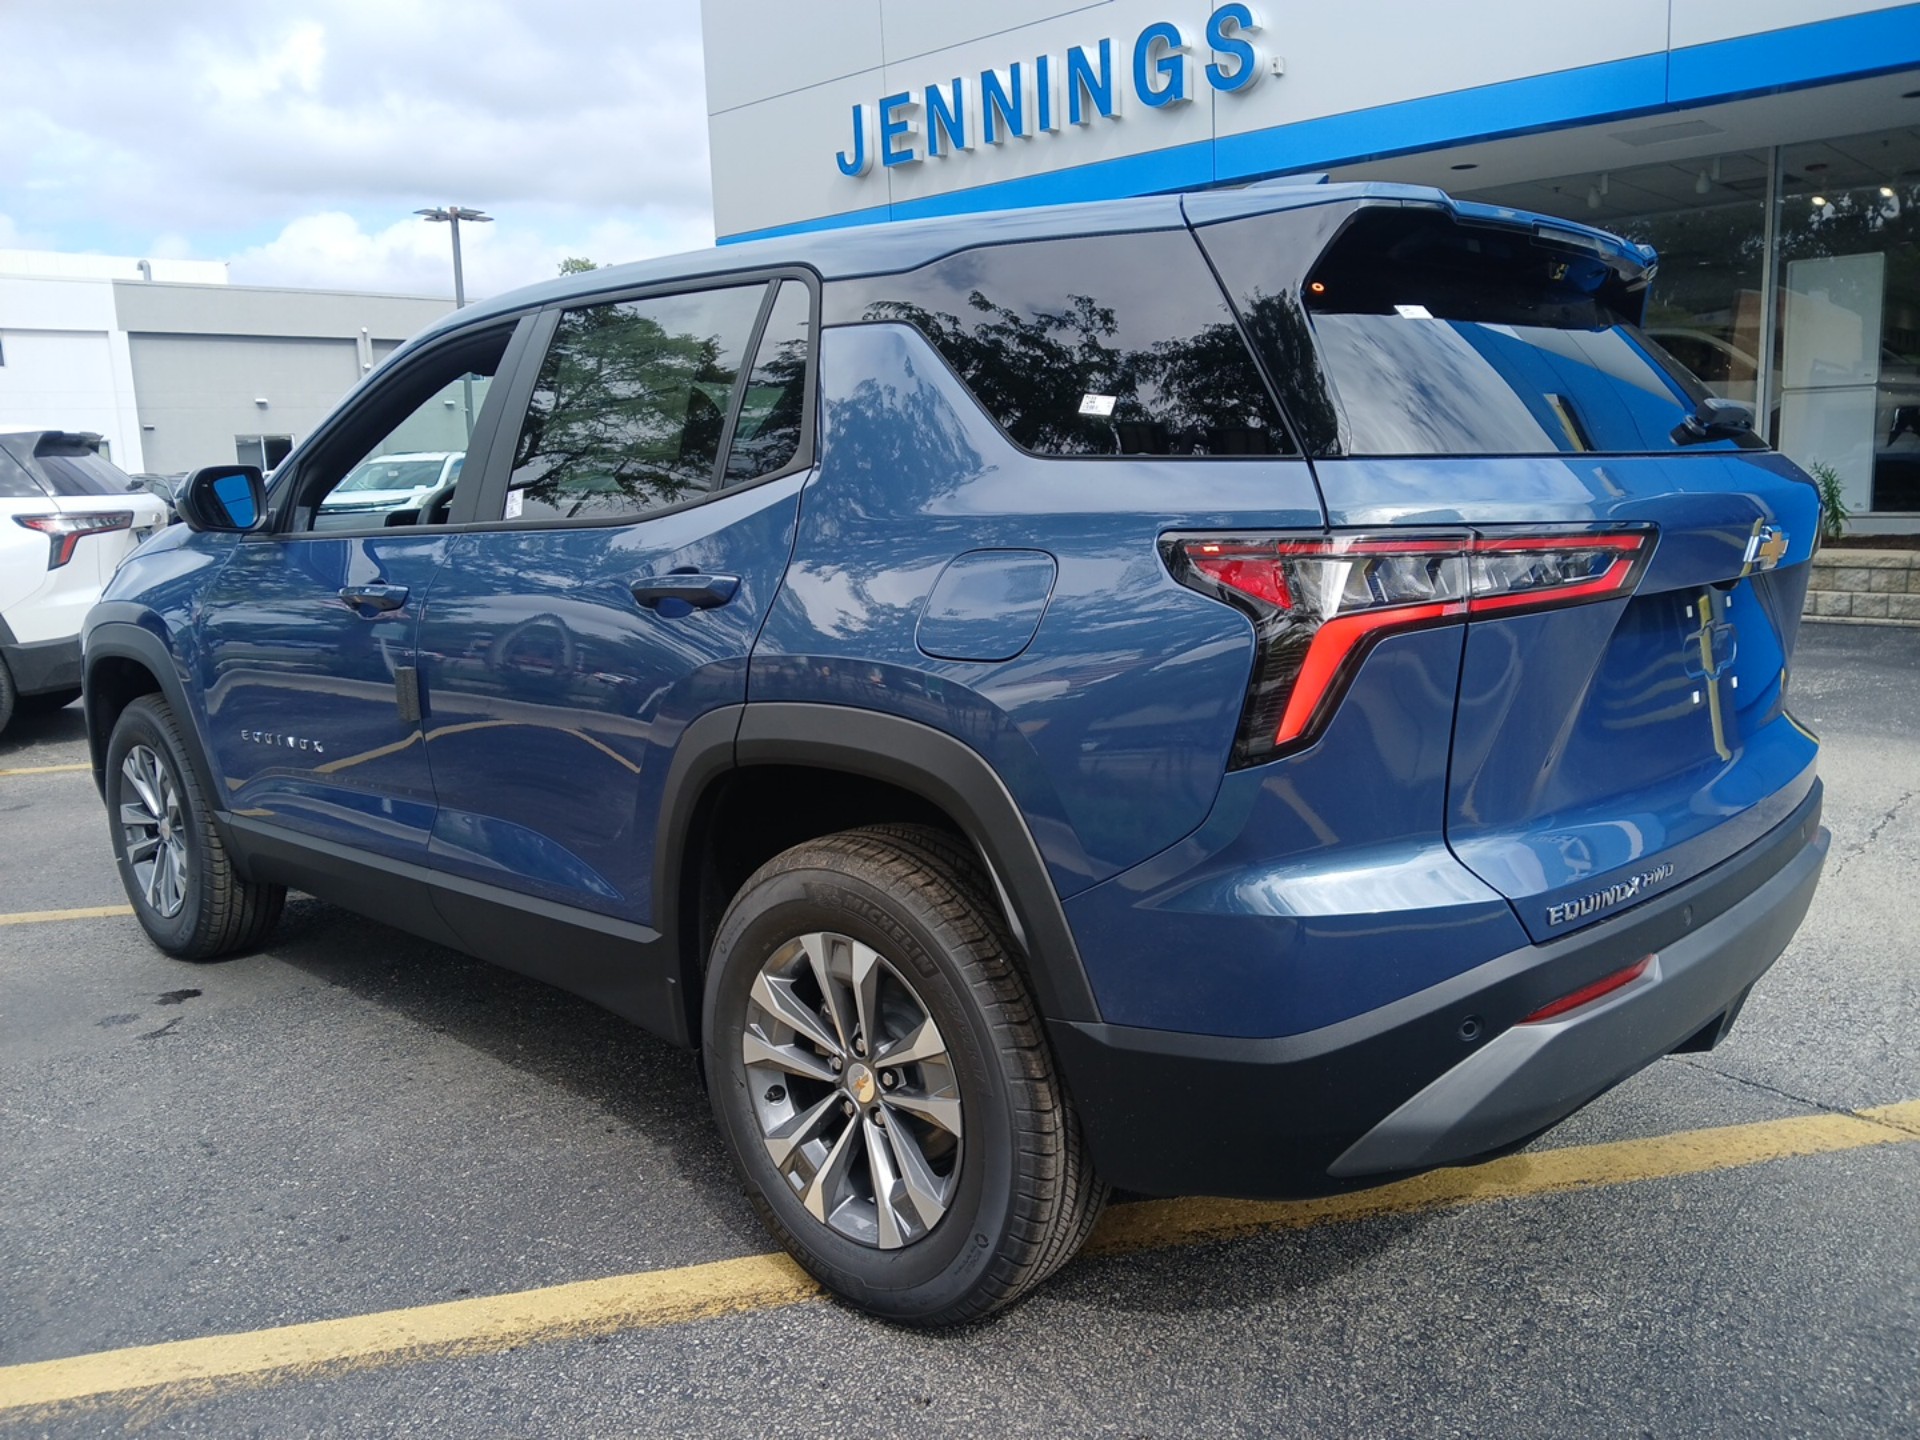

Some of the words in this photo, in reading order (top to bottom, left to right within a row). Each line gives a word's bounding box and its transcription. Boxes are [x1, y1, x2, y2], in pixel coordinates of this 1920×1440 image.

[836, 2, 1261, 177] JENNINGS
[241, 730, 324, 753] EQUINOX
[843, 893, 935, 974] MICHELIN
[1547, 875, 1640, 926] EQUINOX
